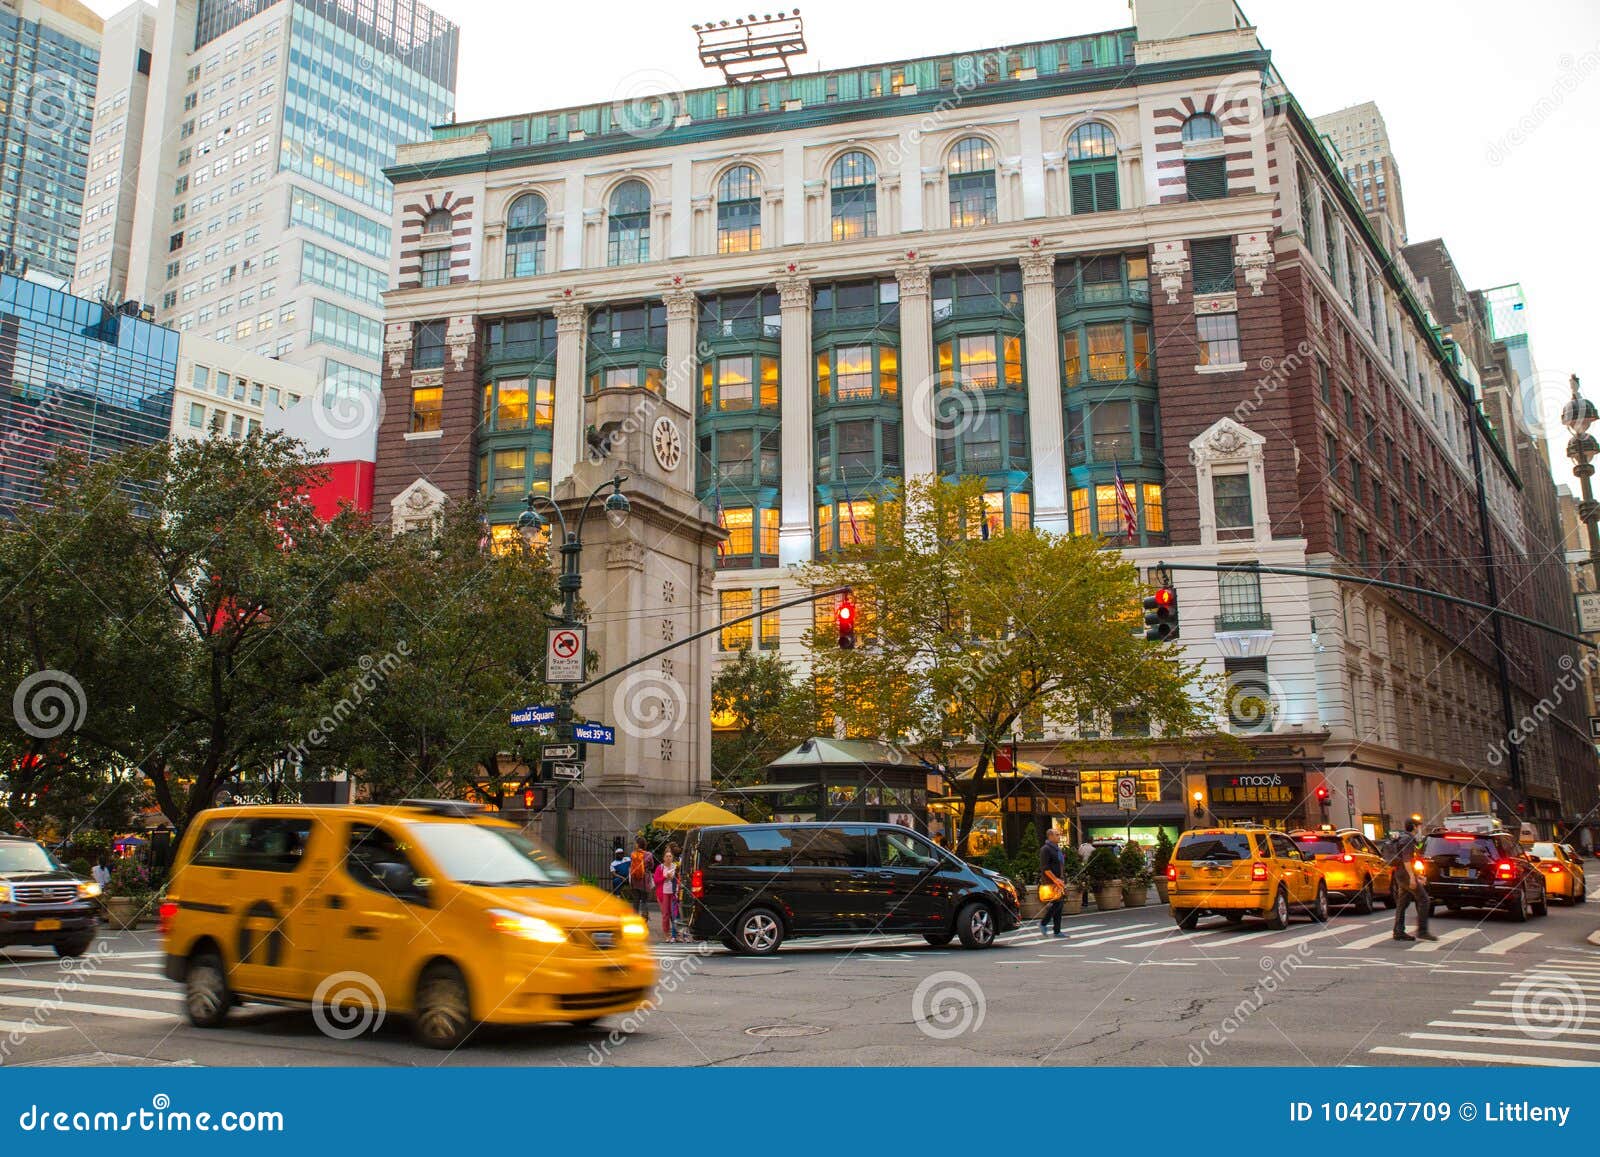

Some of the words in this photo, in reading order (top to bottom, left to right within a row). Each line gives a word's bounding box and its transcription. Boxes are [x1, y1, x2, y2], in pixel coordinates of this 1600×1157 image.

[510, 711, 532, 723] Herald
[532, 711, 555, 722] Square
[576, 727, 592, 738] West
[604, 730, 612, 740] St
[1240, 774, 1281, 787] macy's
